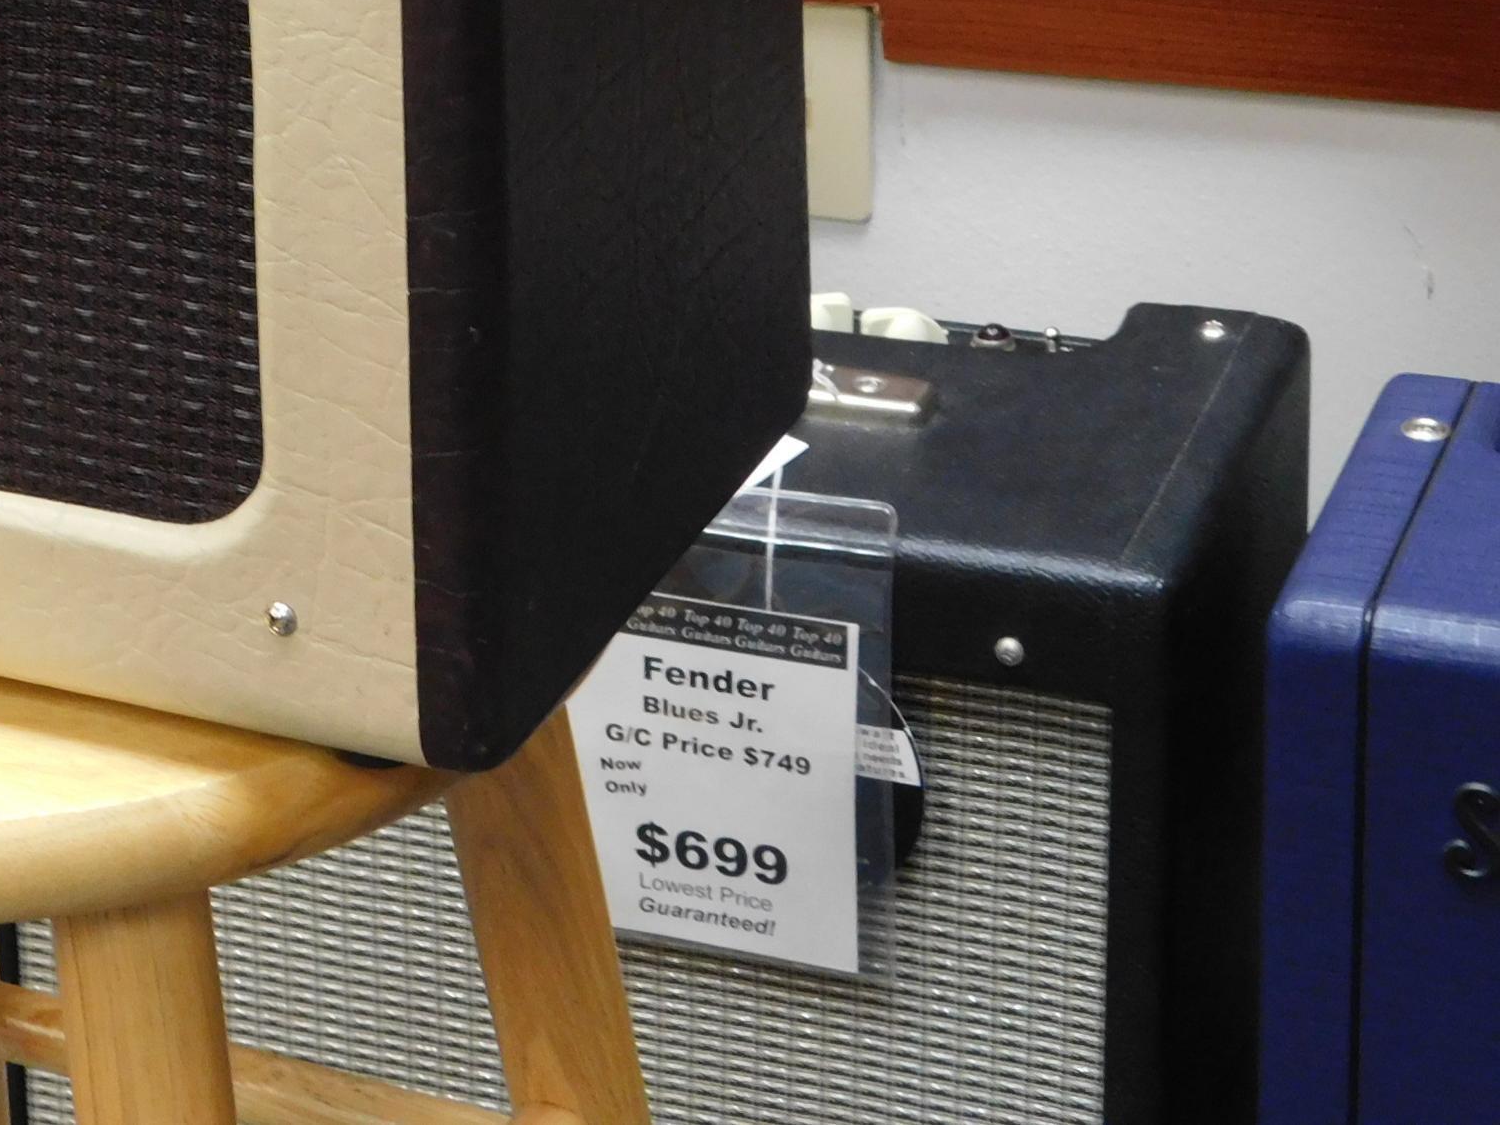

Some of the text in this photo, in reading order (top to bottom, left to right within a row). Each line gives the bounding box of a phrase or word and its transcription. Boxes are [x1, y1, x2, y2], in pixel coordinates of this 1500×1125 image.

[657, 606, 678, 619] 40
[684, 608, 710, 627] Top
[713, 615, 733, 627] 40
[737, 617, 764, 636] Top
[767, 623, 787, 637] 40
[793, 626, 820, 644] Top
[823, 632, 843, 646] 40
[681, 626, 732, 646] Guitars
[735, 635, 786, 655] Guitars
[790, 644, 842, 664] Guitars
[643, 655, 776, 701] Fender
[643, 696, 764, 733] Blues Jr.
[601, 757, 642, 772] Now
[605, 723, 811, 776] G/C Price $749
[605, 780, 648, 797] Only
[635, 821, 789, 885] $699
[638, 871, 774, 912] Lowest Price
[638, 895, 777, 936] Guaranteed!
